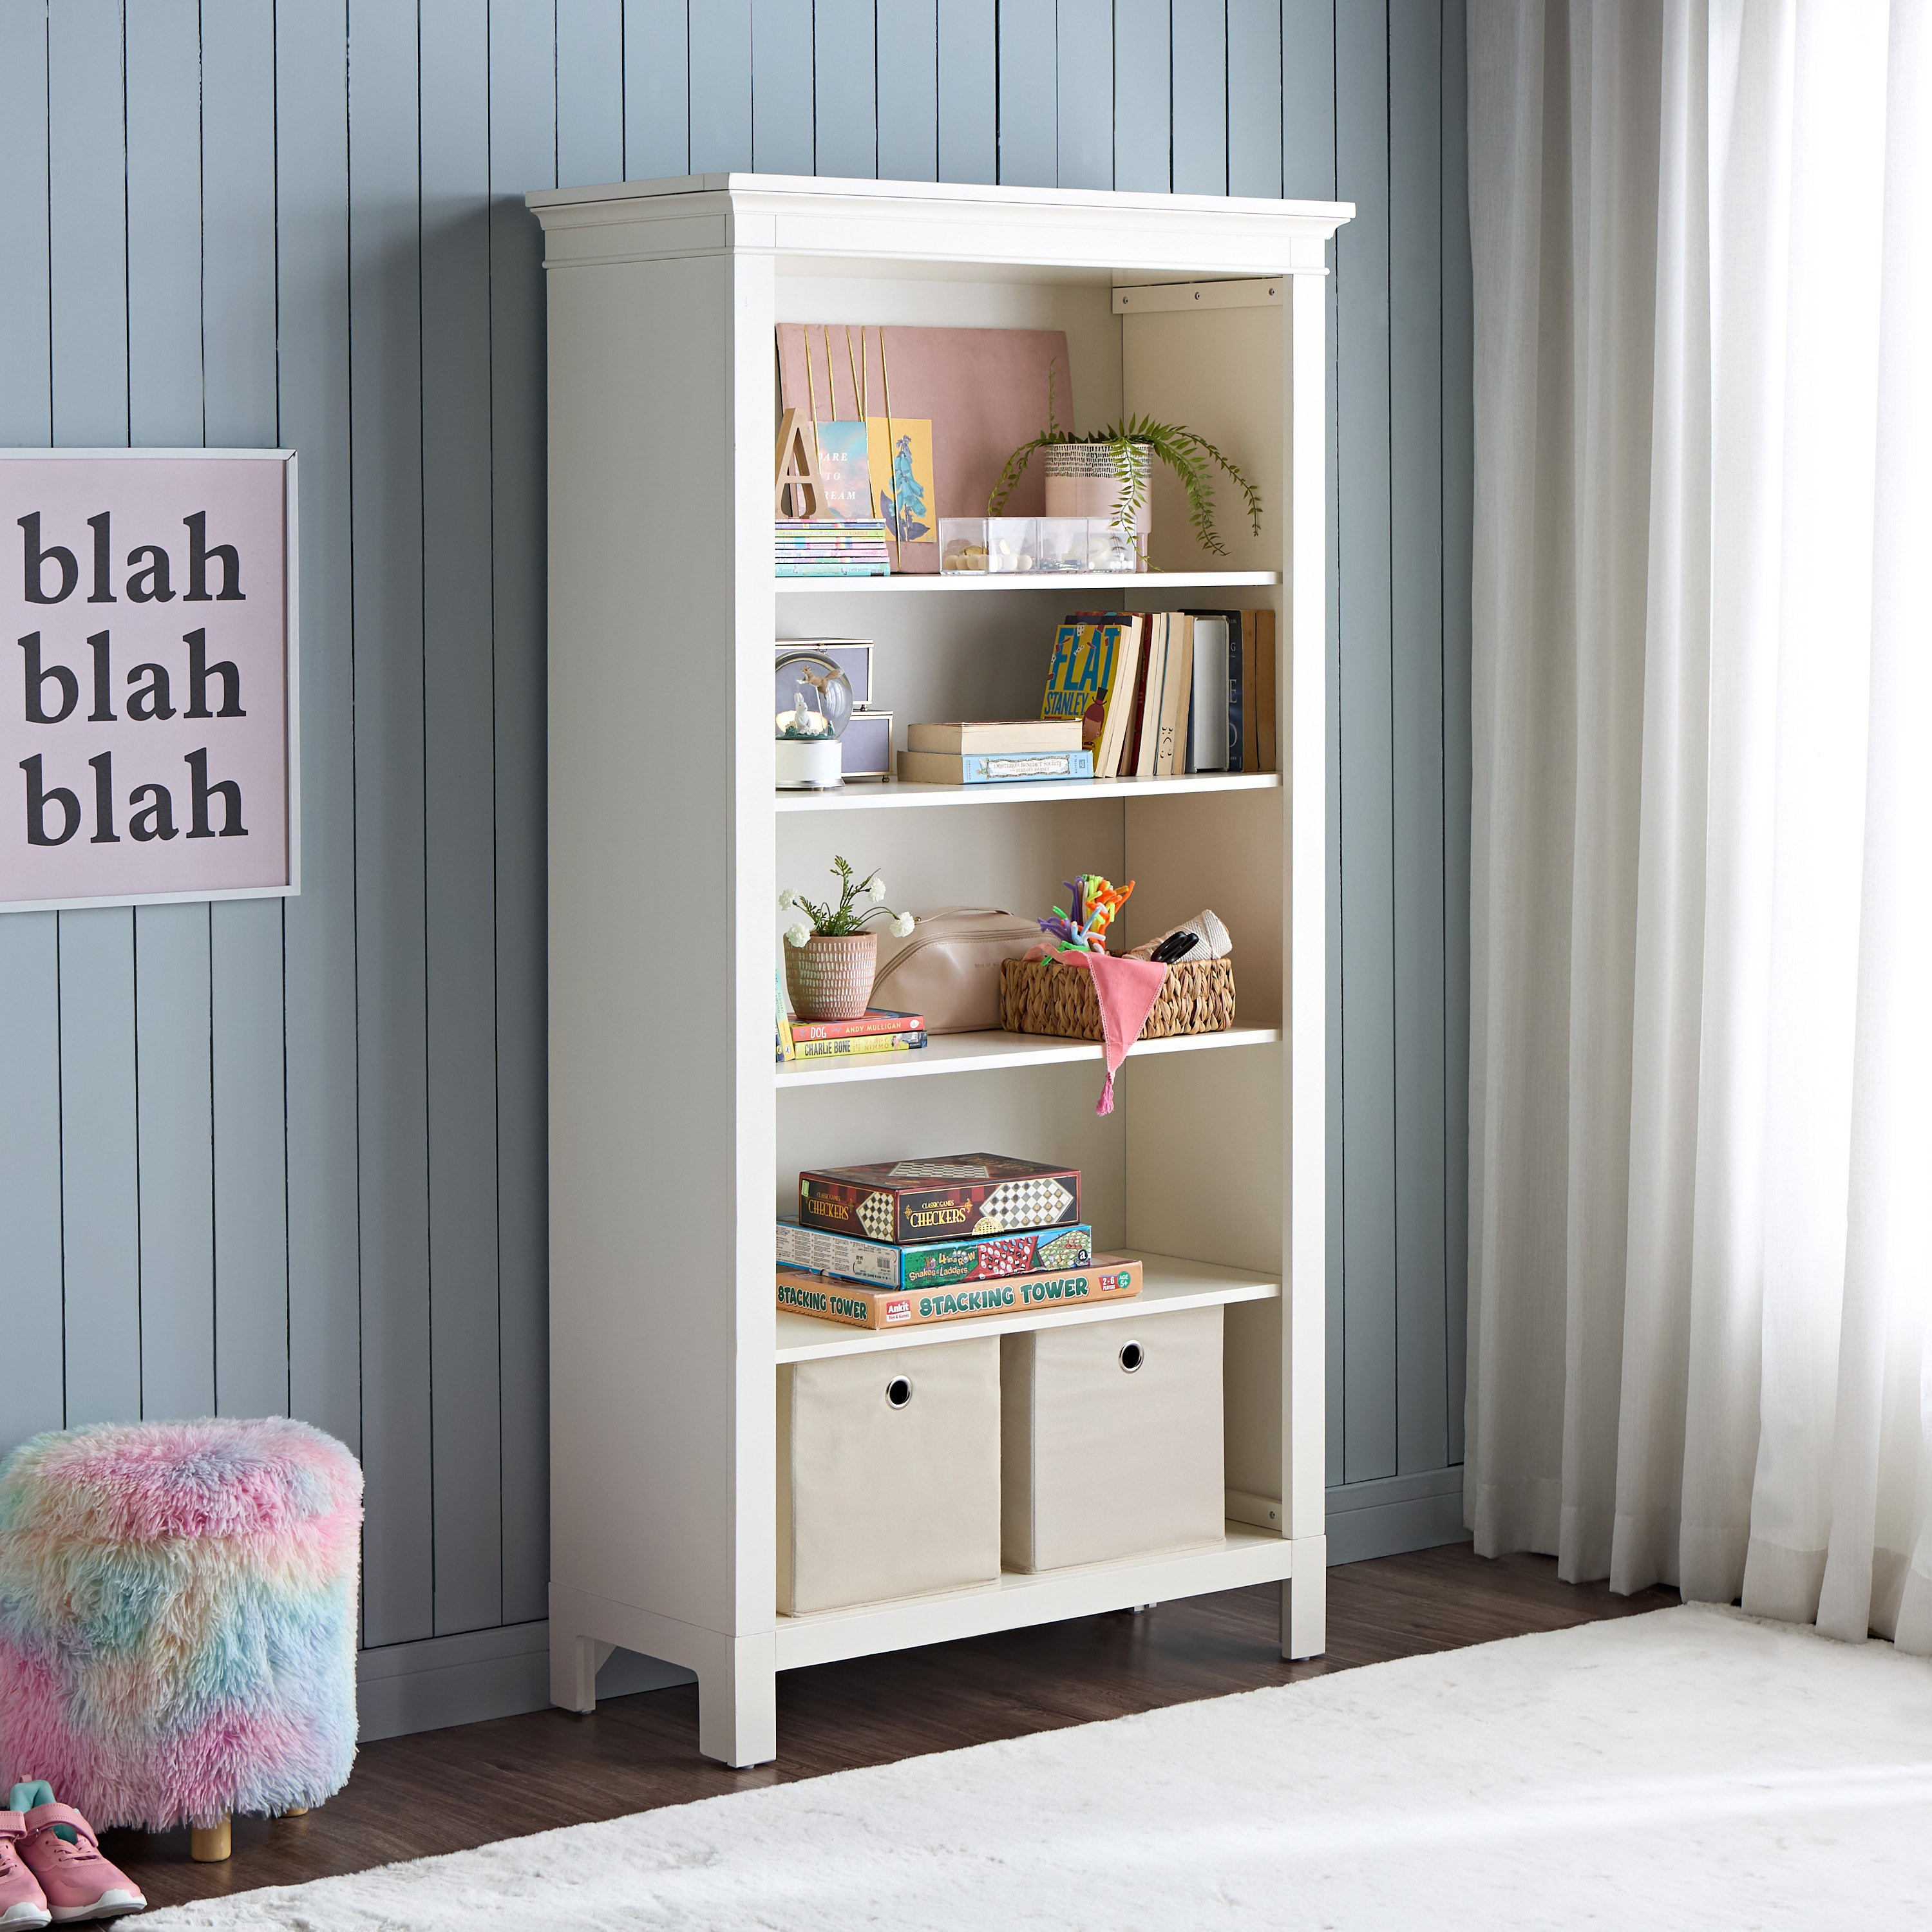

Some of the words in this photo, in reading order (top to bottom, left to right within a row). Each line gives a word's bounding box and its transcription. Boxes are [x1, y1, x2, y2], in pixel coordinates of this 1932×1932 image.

[825, 471, 841, 480] TO
[824, 491, 857, 500] REAM
[17, 511, 246, 604] blah
[1048, 627, 1121, 692] FLAT
[17, 628, 246, 724] blah
[1044, 691, 1089, 716] STANLEY
[19, 747, 249, 846] blah
[810, 1027, 827, 1039] DOG
[867, 1022, 902, 1031] MULLIGAN
[834, 1040, 851, 1053] BONE
[808, 1199, 849, 1220] CHECKERS
[910, 1208, 966, 1227] CHECKERS
[939, 1253, 947, 1264] 4
[1079, 1251, 1086, 1260] a
[909, 1268, 936, 1281] Snakes
[940, 1266, 968, 1276] Ladders
[777, 1285, 827, 1312] STACKING
[829, 1295, 867, 1321] TOWER
[919, 1286, 1014, 1318] STACKING
[1021, 1277, 1089, 1303] TOWER
[888, 1301, 909, 1314] Ankit
